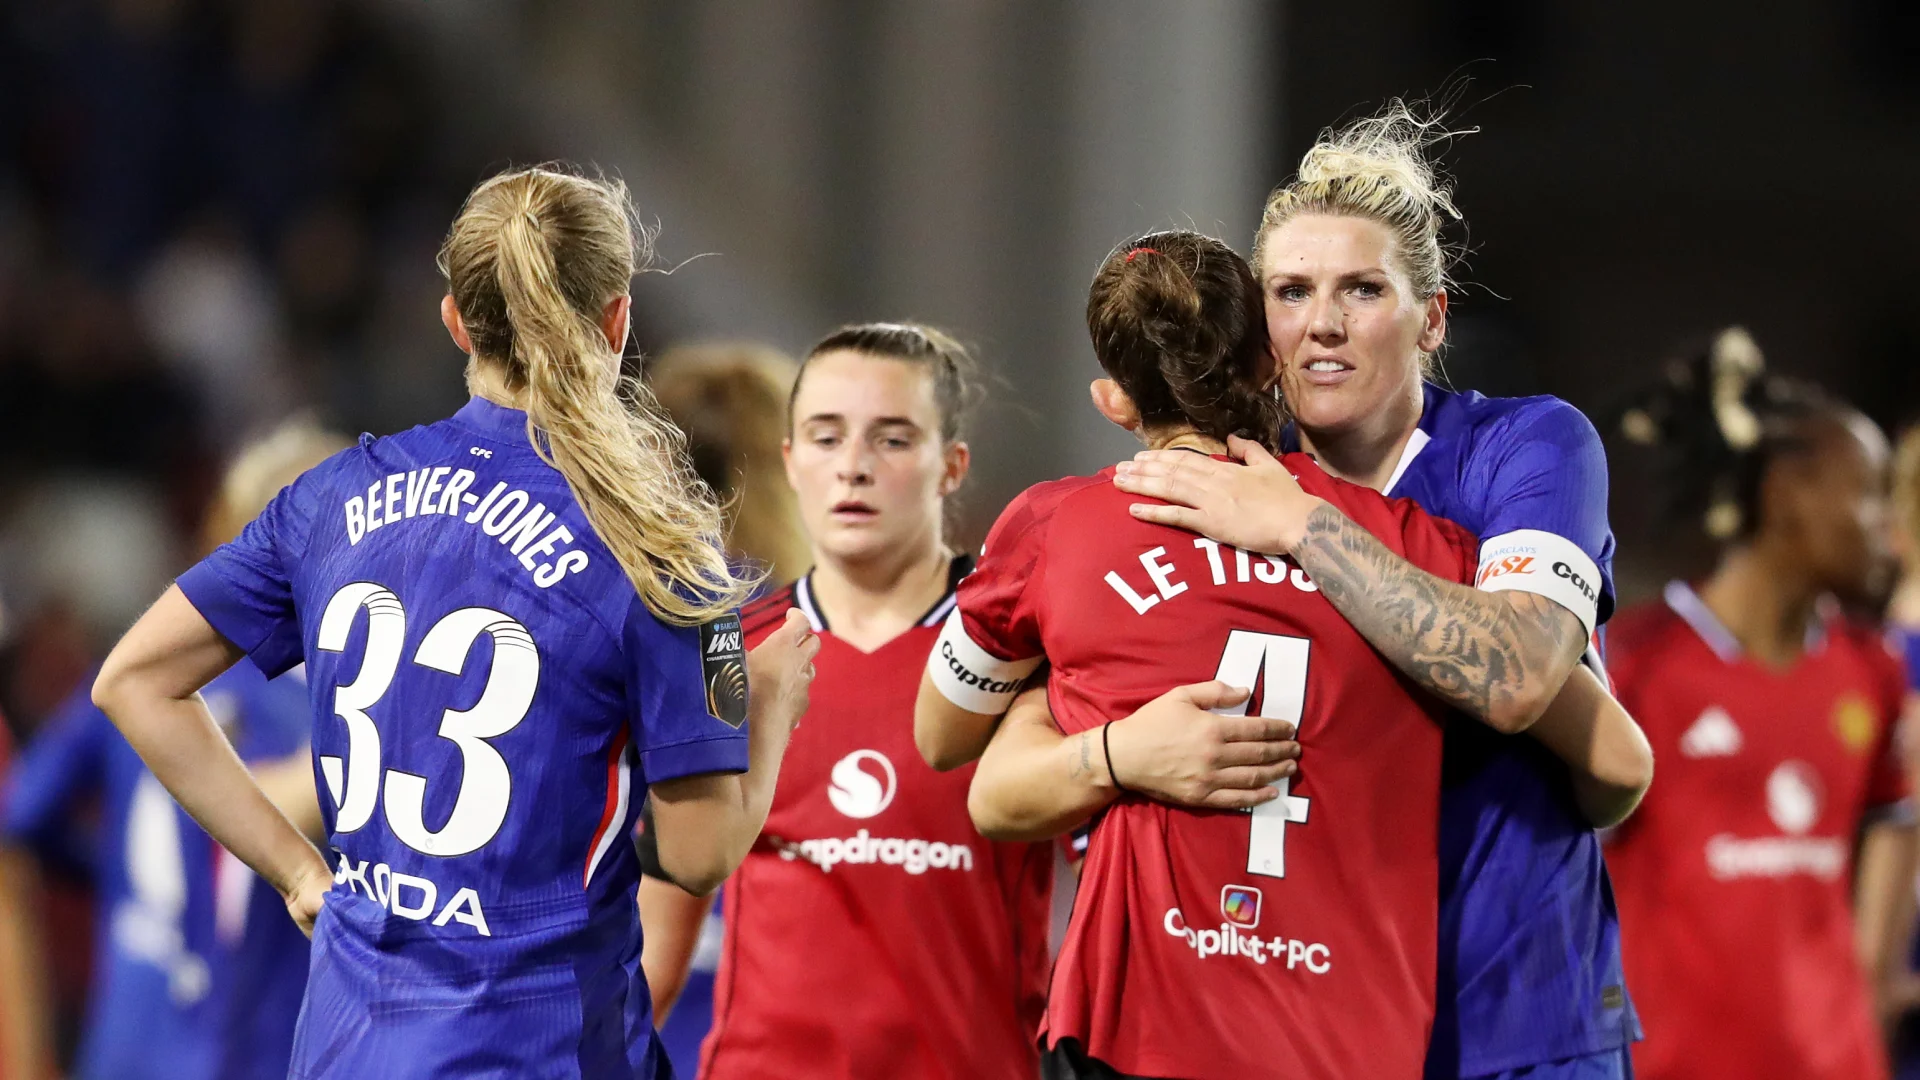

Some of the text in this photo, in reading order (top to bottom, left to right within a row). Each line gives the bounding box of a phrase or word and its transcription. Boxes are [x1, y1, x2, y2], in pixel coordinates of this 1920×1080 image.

[469, 446, 493, 459] CFC
[345, 466, 589, 589] BEEVER-JONES
[1104, 546, 1188, 615] LE
[1552, 561, 1599, 611] Cap
[706, 631, 741, 654] WSL
[317, 580, 541, 858] 33
[1205, 628, 1311, 878] 4
